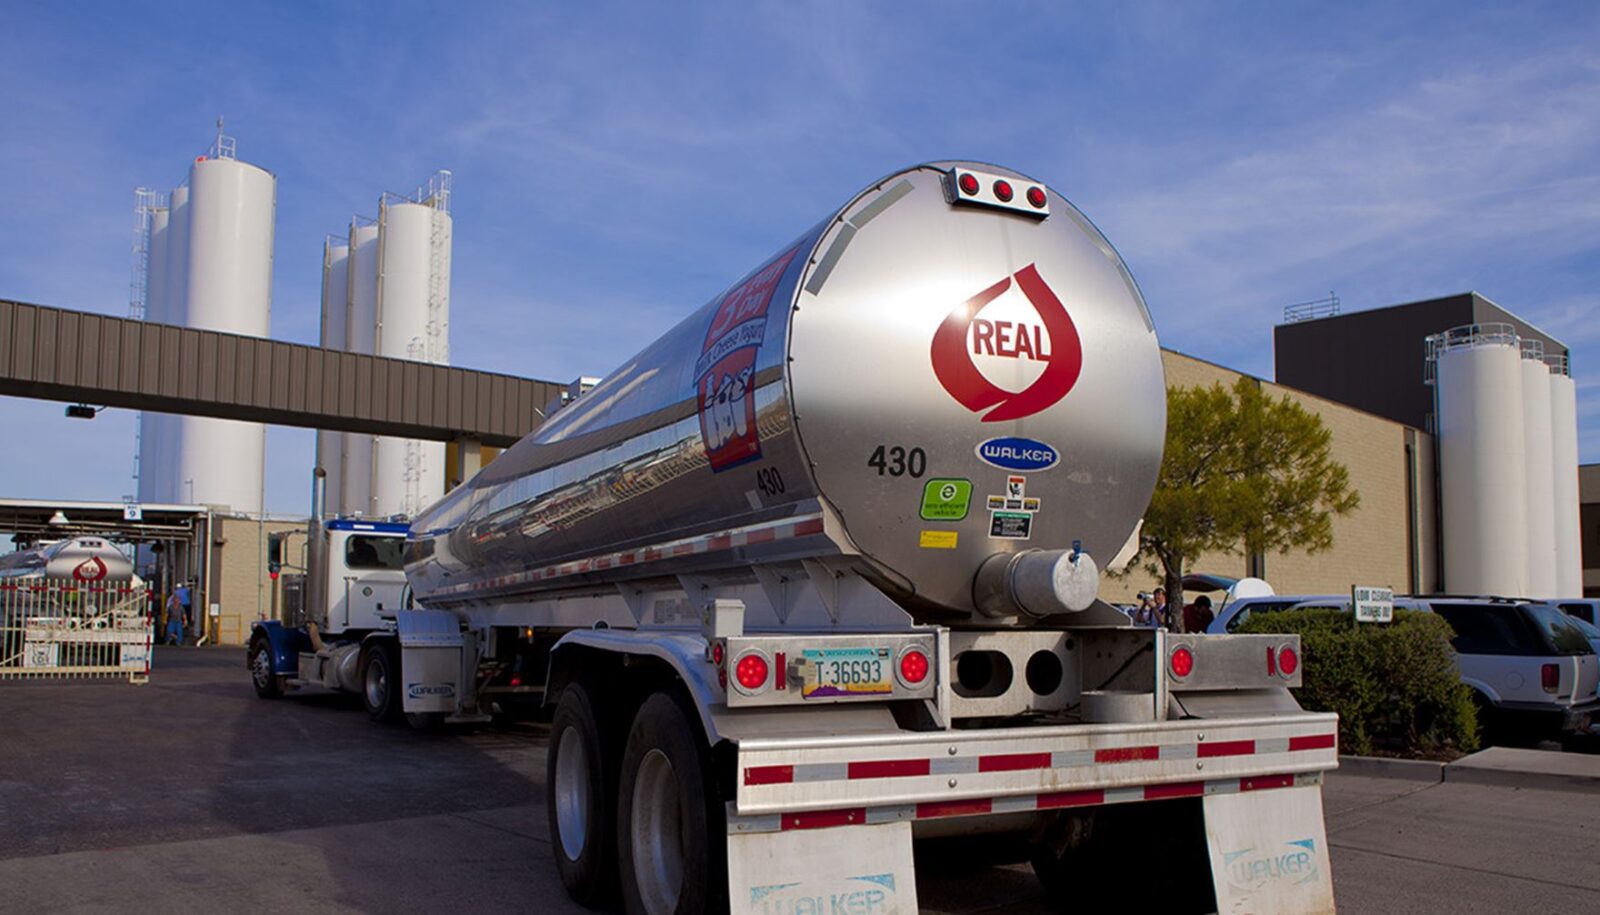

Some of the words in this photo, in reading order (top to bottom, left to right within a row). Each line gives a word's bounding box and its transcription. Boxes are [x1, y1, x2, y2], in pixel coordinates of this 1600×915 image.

[972, 318, 1051, 362] REAL
[868, 445, 927, 479] 430
[984, 445, 1053, 462] WALKER
[756, 466, 785, 495] 430
[1231, 852, 1311, 883] WALKER
